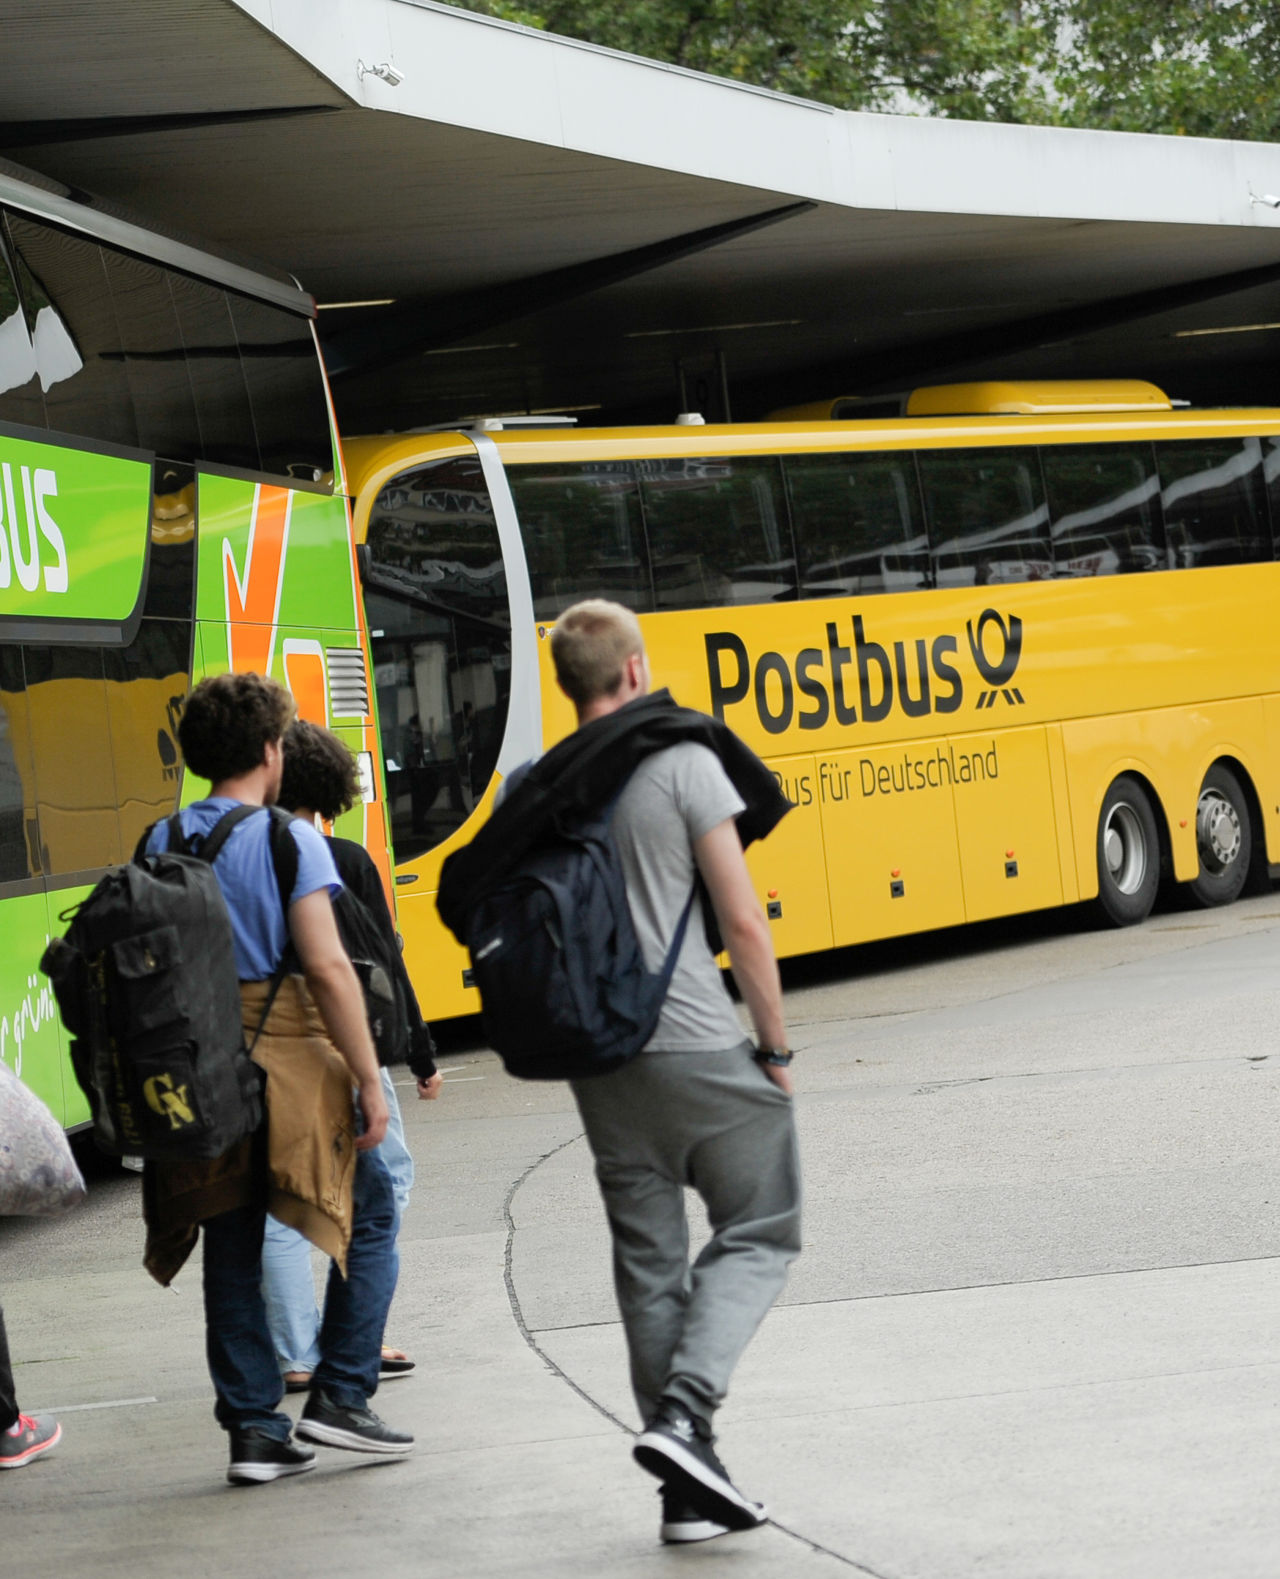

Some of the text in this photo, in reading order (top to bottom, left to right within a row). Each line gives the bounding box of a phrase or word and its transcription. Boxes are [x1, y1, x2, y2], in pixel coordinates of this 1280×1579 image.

[704, 614, 963, 734] Postbus
[820, 762, 851, 803] für
[859, 740, 999, 798] Deutschland
